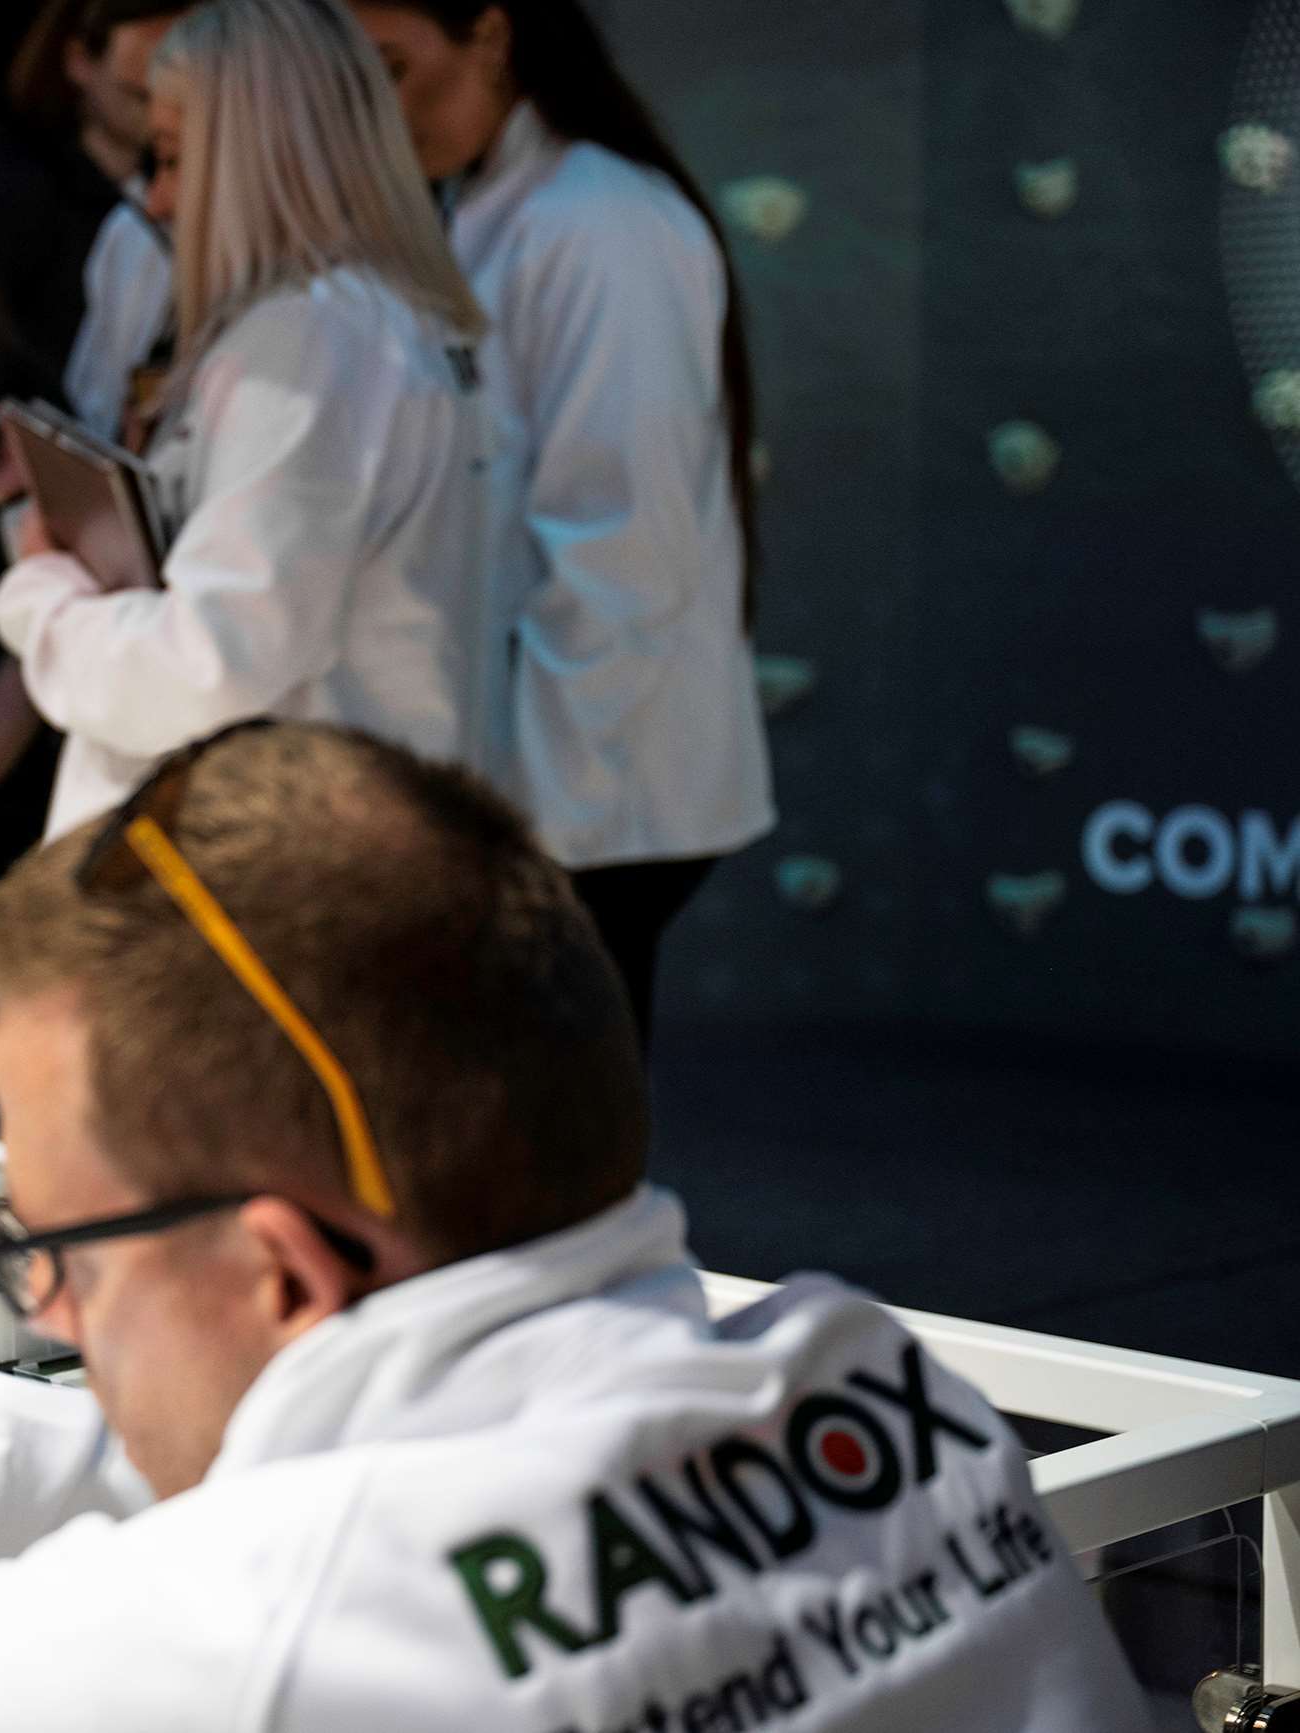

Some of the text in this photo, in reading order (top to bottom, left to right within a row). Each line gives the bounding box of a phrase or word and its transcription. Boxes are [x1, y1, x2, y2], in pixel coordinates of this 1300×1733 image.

[450, 1338, 991, 1679] RANDOX
[801, 1566, 954, 1677] Your
[945, 1502, 1055, 1599] Life
